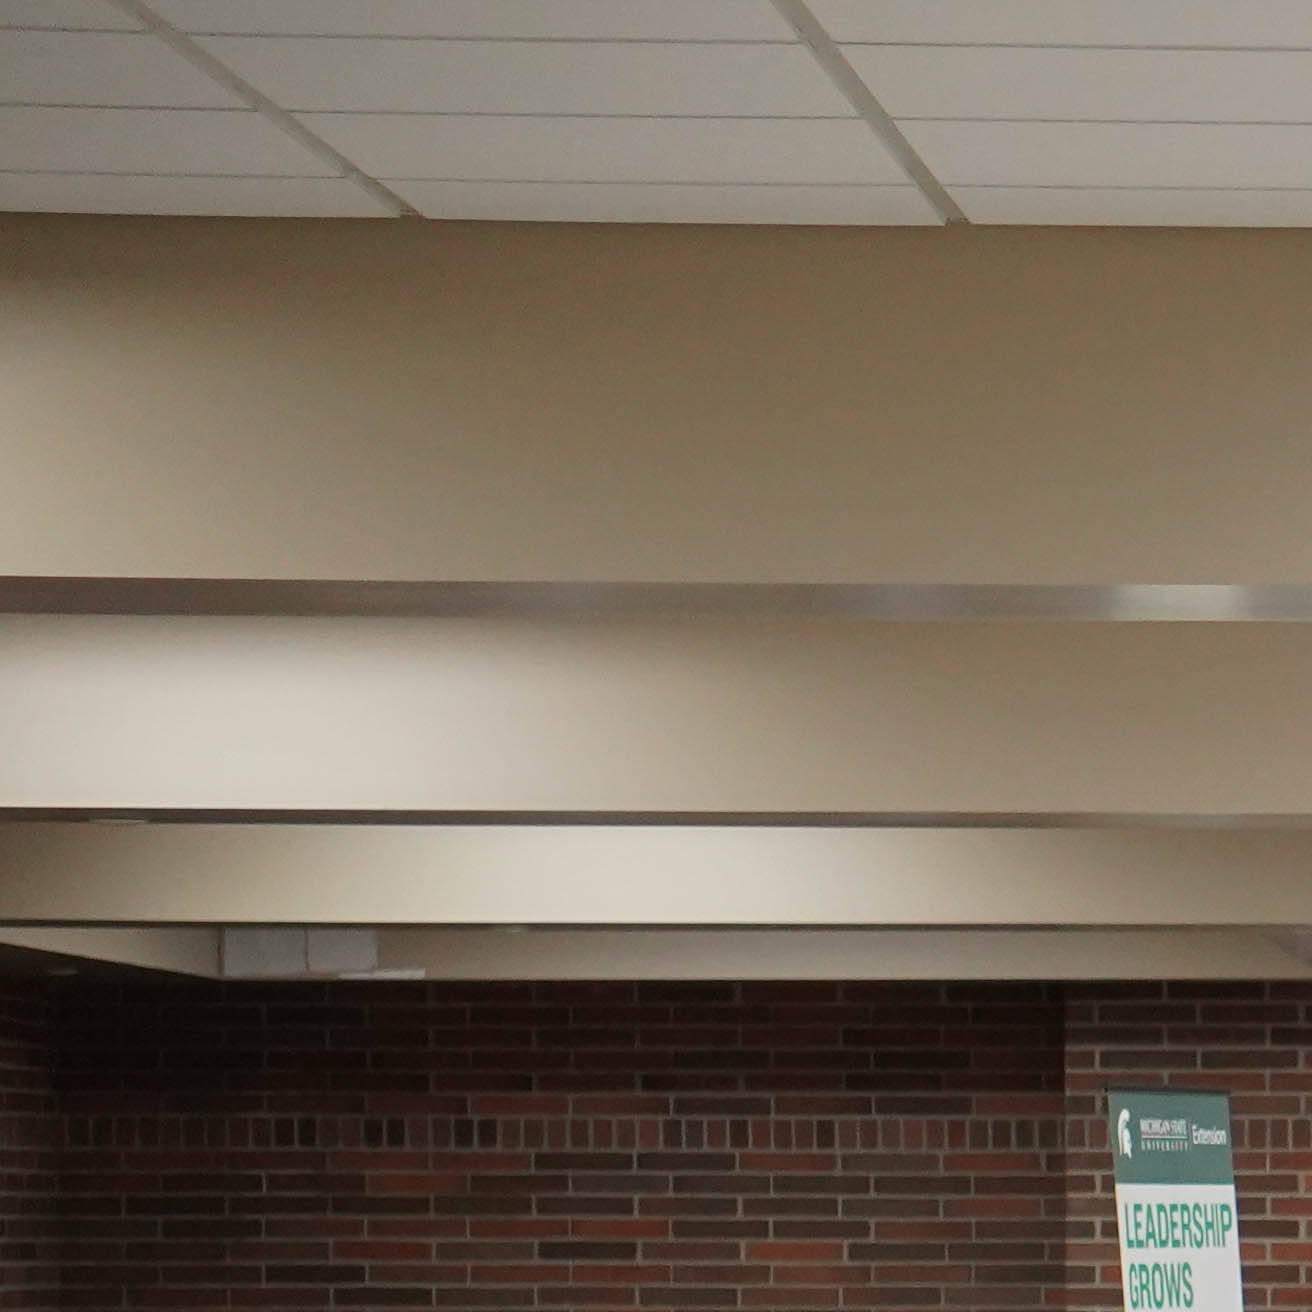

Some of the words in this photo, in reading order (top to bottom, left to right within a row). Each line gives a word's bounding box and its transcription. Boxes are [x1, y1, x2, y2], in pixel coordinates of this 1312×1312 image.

[1140, 1119, 1169, 1134] MICHIGAN
[1170, 1119, 1187, 1135] STATE
[1192, 1125, 1227, 1145] Extension
[1141, 1140, 1188, 1151] UNIVERSITY
[1125, 1203, 1232, 1249] LEADERSHIP
[1129, 1261, 1194, 1310] GROWS
